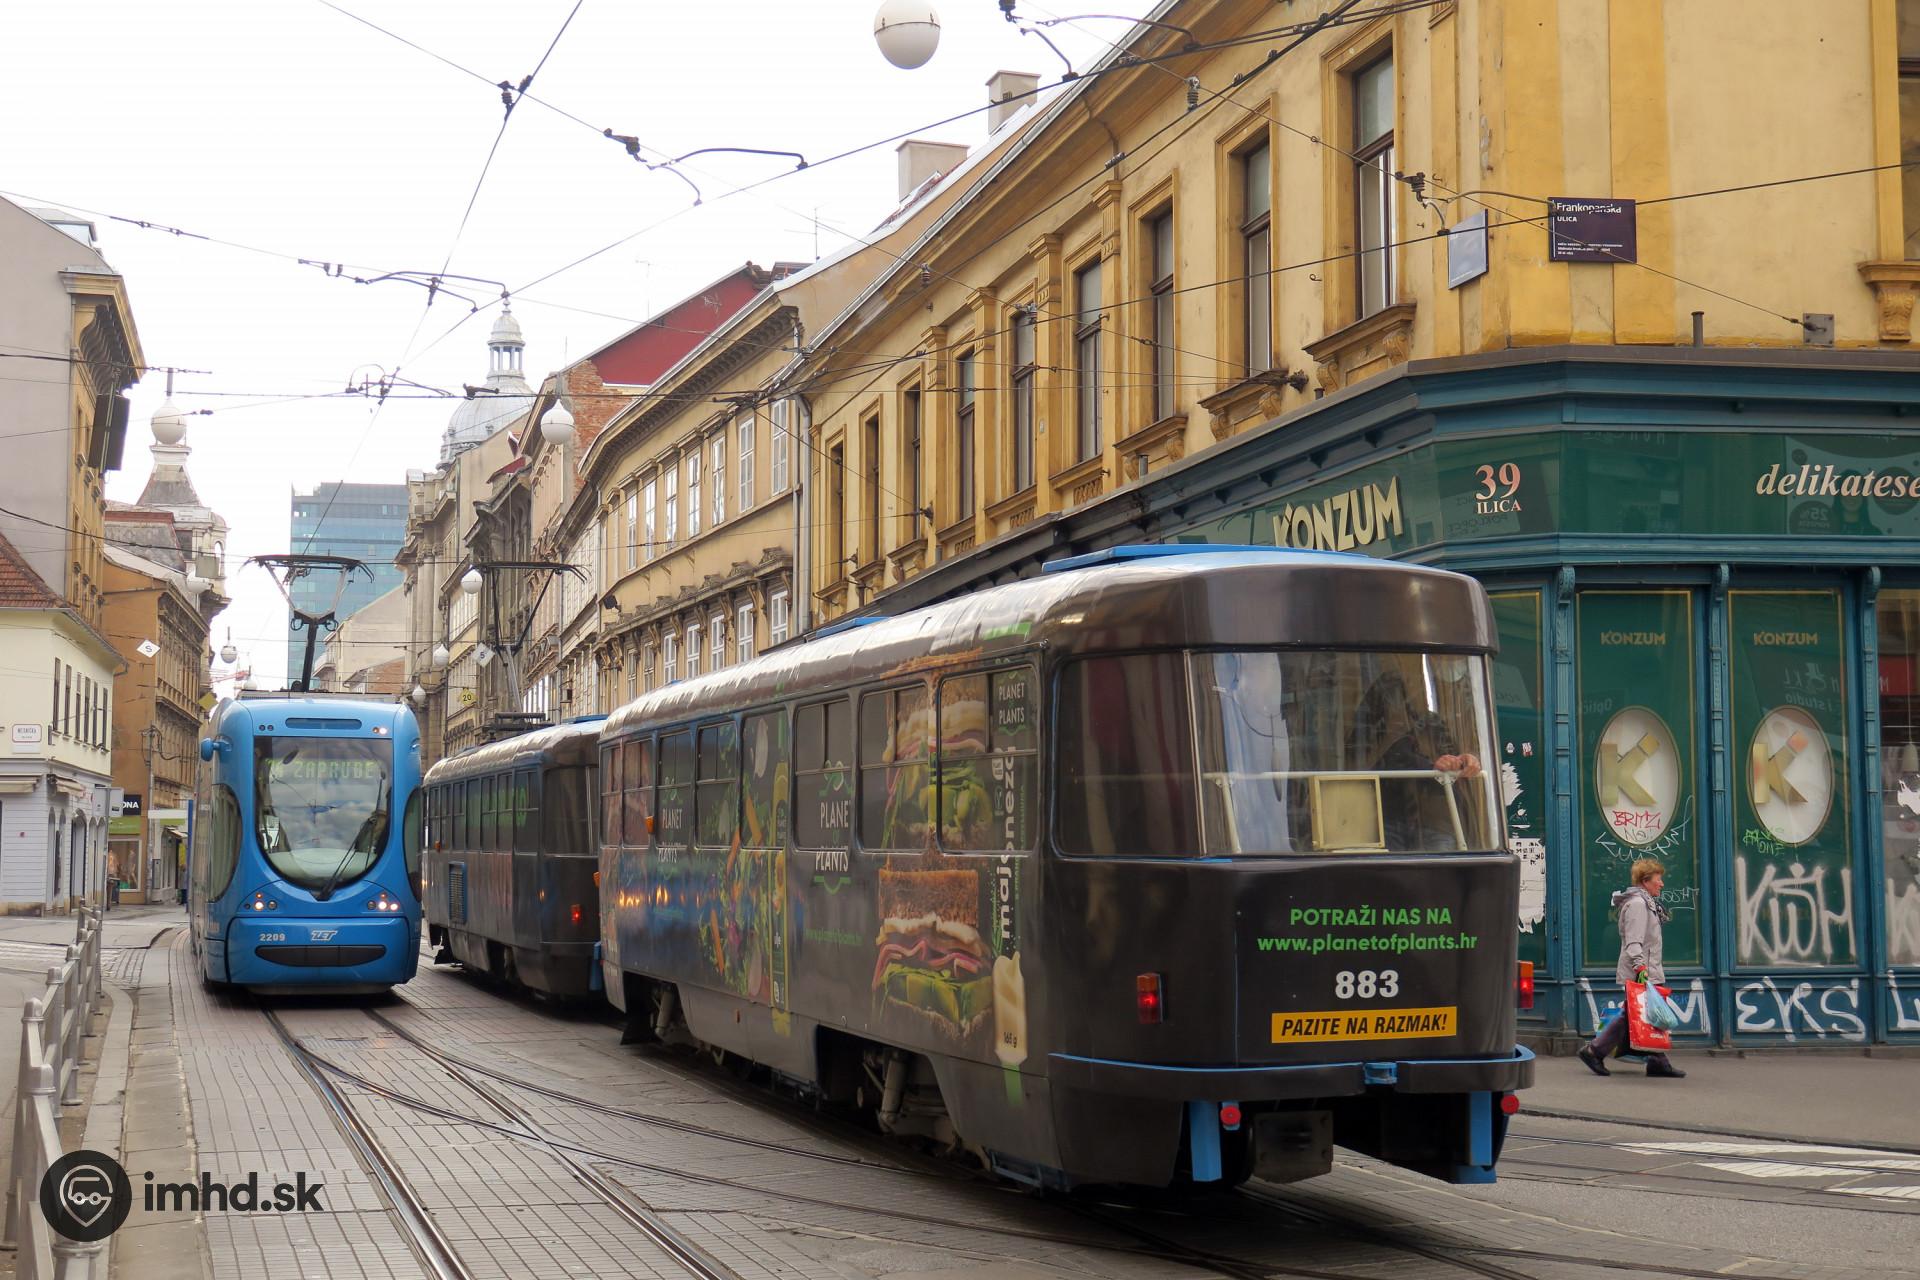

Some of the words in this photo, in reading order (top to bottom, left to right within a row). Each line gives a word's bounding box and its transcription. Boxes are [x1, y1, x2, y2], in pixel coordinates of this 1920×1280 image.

[1475, 462, 1521, 500] 39
[1273, 475, 1404, 552] KONZUM
[1477, 499, 1522, 514] ILICA
[1600, 630, 1666, 645] KONZUM
[1753, 630, 1818, 645] KONZUM
[462, 694, 472, 702] 20
[998, 682, 1025, 700] PLANET
[998, 707, 1025, 725] PLANTS
[662, 808, 683, 829] PLANET
[820, 801, 851, 829] PLANE
[997, 745, 1016, 939] majoneza
[1290, 904, 1376, 925] POTRAŽI
[1382, 908, 1421, 925] NAS
[1426, 908, 1452, 924] NA
[259, 933, 286, 941] 2209
[1257, 932, 1478, 955] www.planetofplants.hr
[1335, 969, 1399, 999] 883
[1281, 1017, 1341, 1037] PAZITE
[1345, 1016, 1369, 1034] NA
[1374, 1013, 1448, 1034] RAZMAK!
